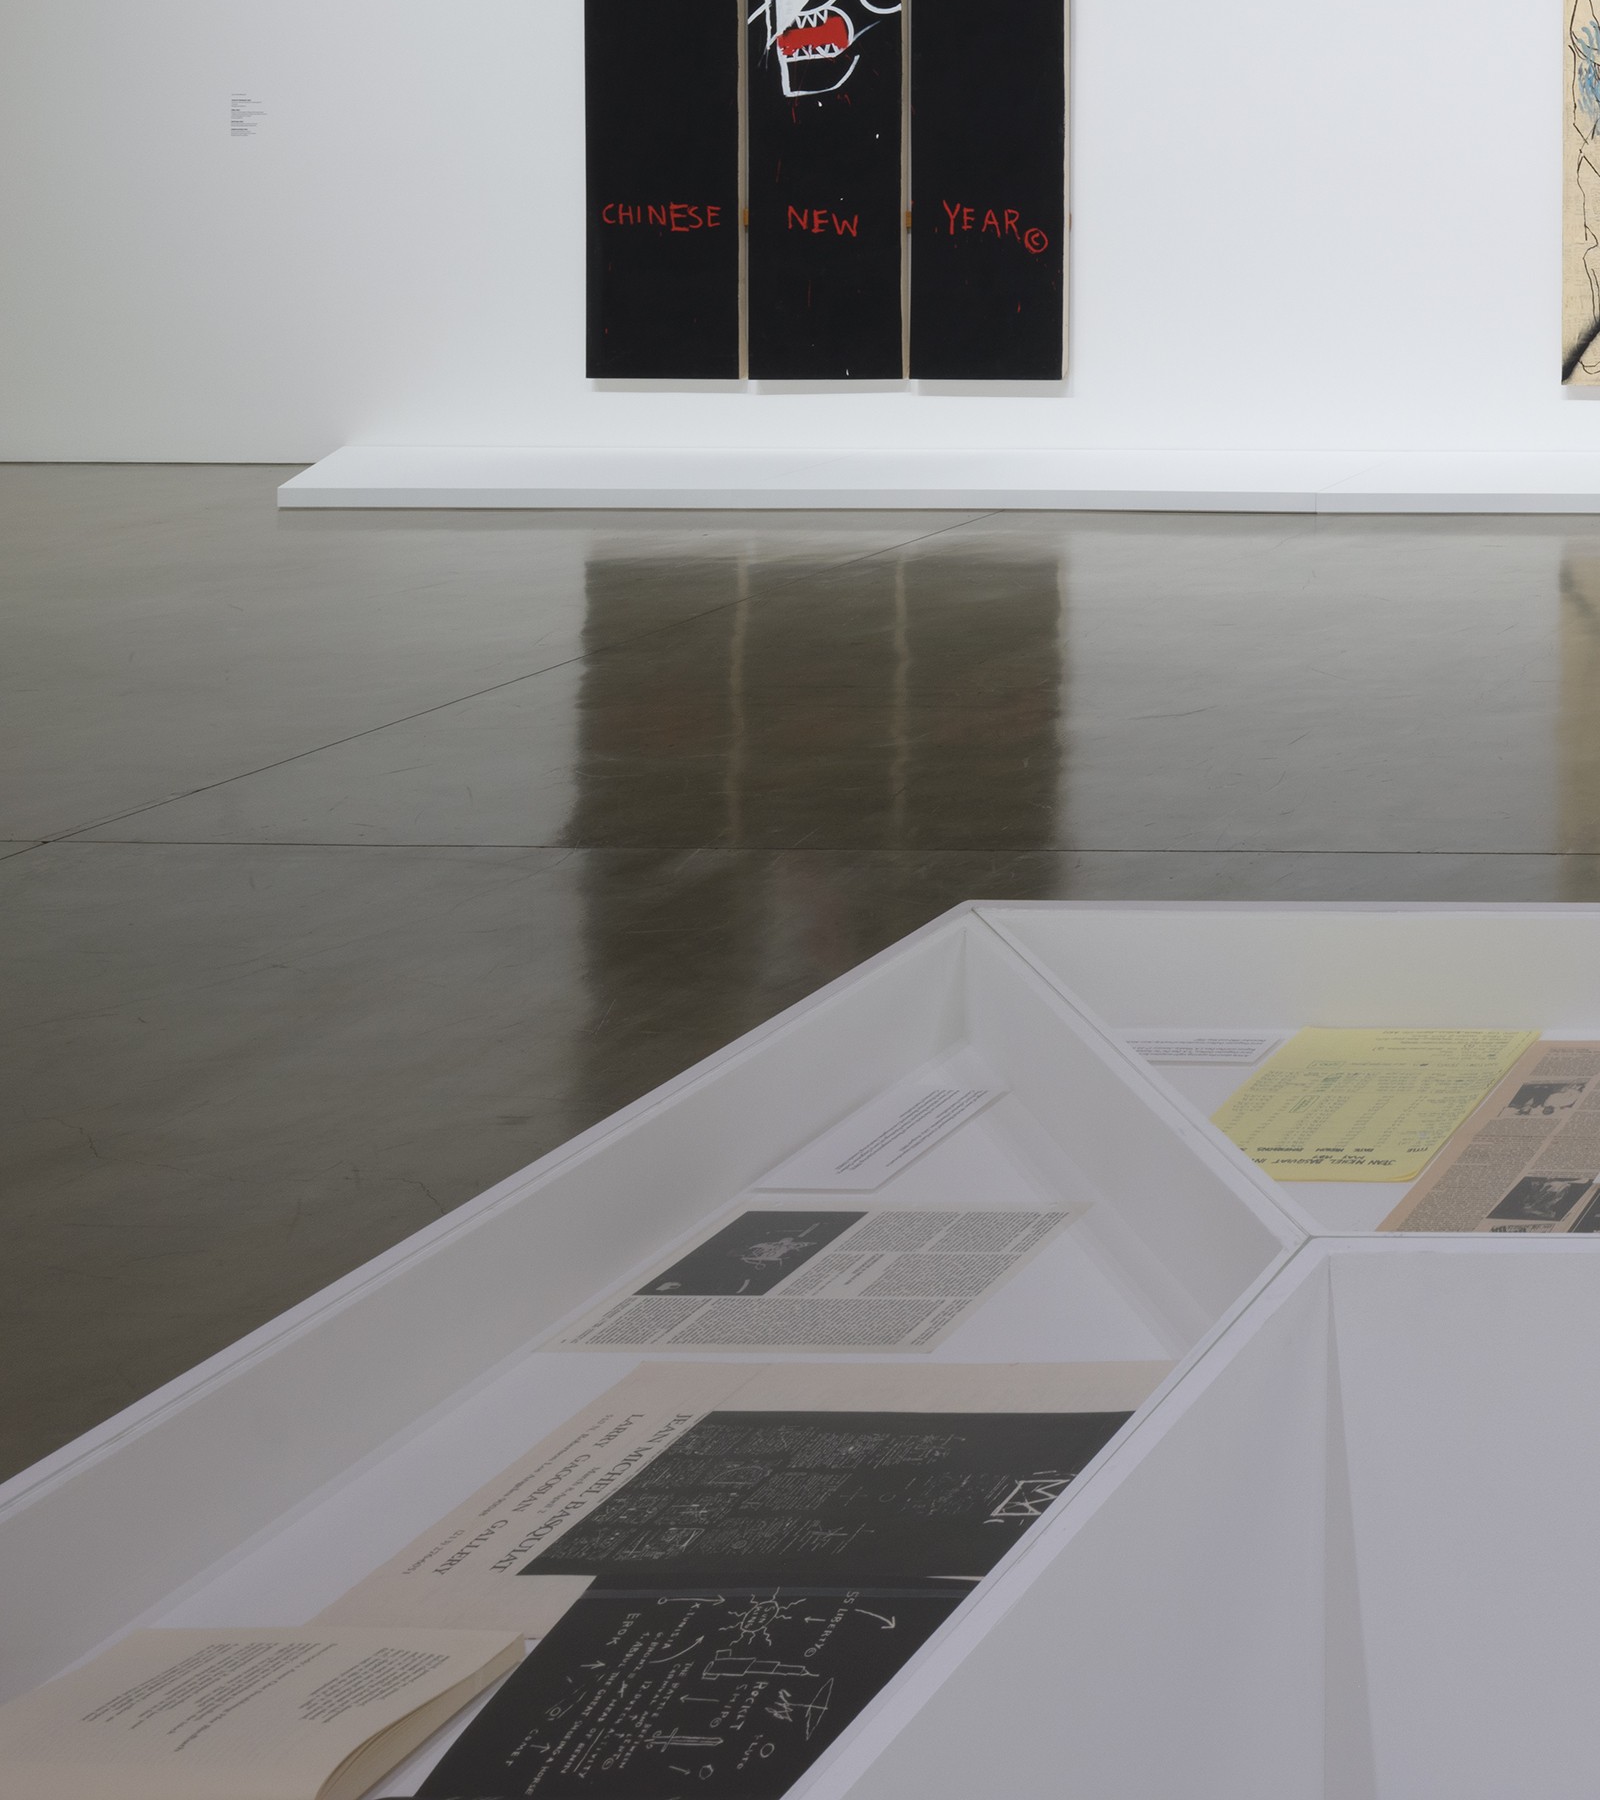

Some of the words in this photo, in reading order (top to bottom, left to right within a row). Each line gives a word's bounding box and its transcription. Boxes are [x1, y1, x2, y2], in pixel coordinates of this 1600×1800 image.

[602, 202, 722, 231] CHINESE
[787, 205, 858, 237] NEW
[593, 1413, 645, 1449] LARRY
[646, 1413, 693, 1444] JEAN
[511, 1453, 592, 1513] GAGOSIAN
[580, 1446, 653, 1498] MICHEL
[432, 1518, 509, 1576] GALLERY
[489, 1500, 587, 1574] BASQUIAT
